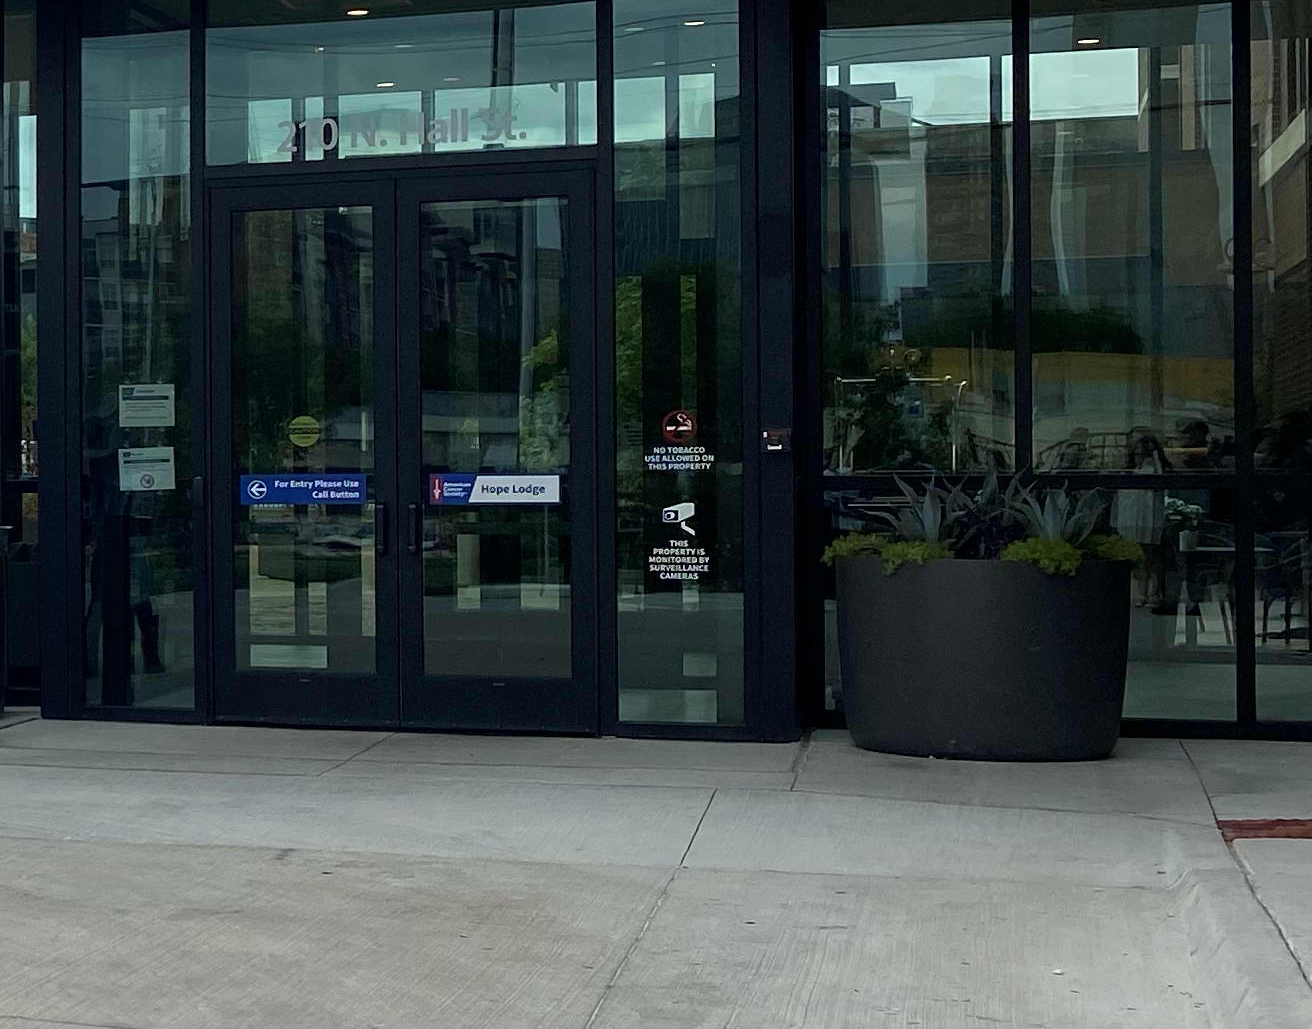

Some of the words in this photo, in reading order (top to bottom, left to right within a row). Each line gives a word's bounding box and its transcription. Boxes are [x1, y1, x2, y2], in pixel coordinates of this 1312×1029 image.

[277, 117, 339, 154] 210
[399, 107, 469, 146] Hall
[653, 446, 666, 454] NO
[667, 446, 706, 454] TOBACCO
[668, 462, 712, 470] PROPERTY
[274, 480, 288, 488] For
[290, 480, 313, 489] Entry
[315, 480, 342, 488] Please
[343, 480, 359, 488] Use
[481, 484, 511, 495] Hope
[512, 484, 546, 496] Lodge
[312, 490, 329, 499] Call
[330, 490, 360, 499] Button
[669, 539, 689, 547] THIS
[652, 548, 696, 556] PROPERTY
[648, 556, 698, 564] MONITORED
[698, 556, 710, 564] BY
[649, 564, 710, 572] SURVEILLANCE
[659, 572, 700, 580] CAMERAS
